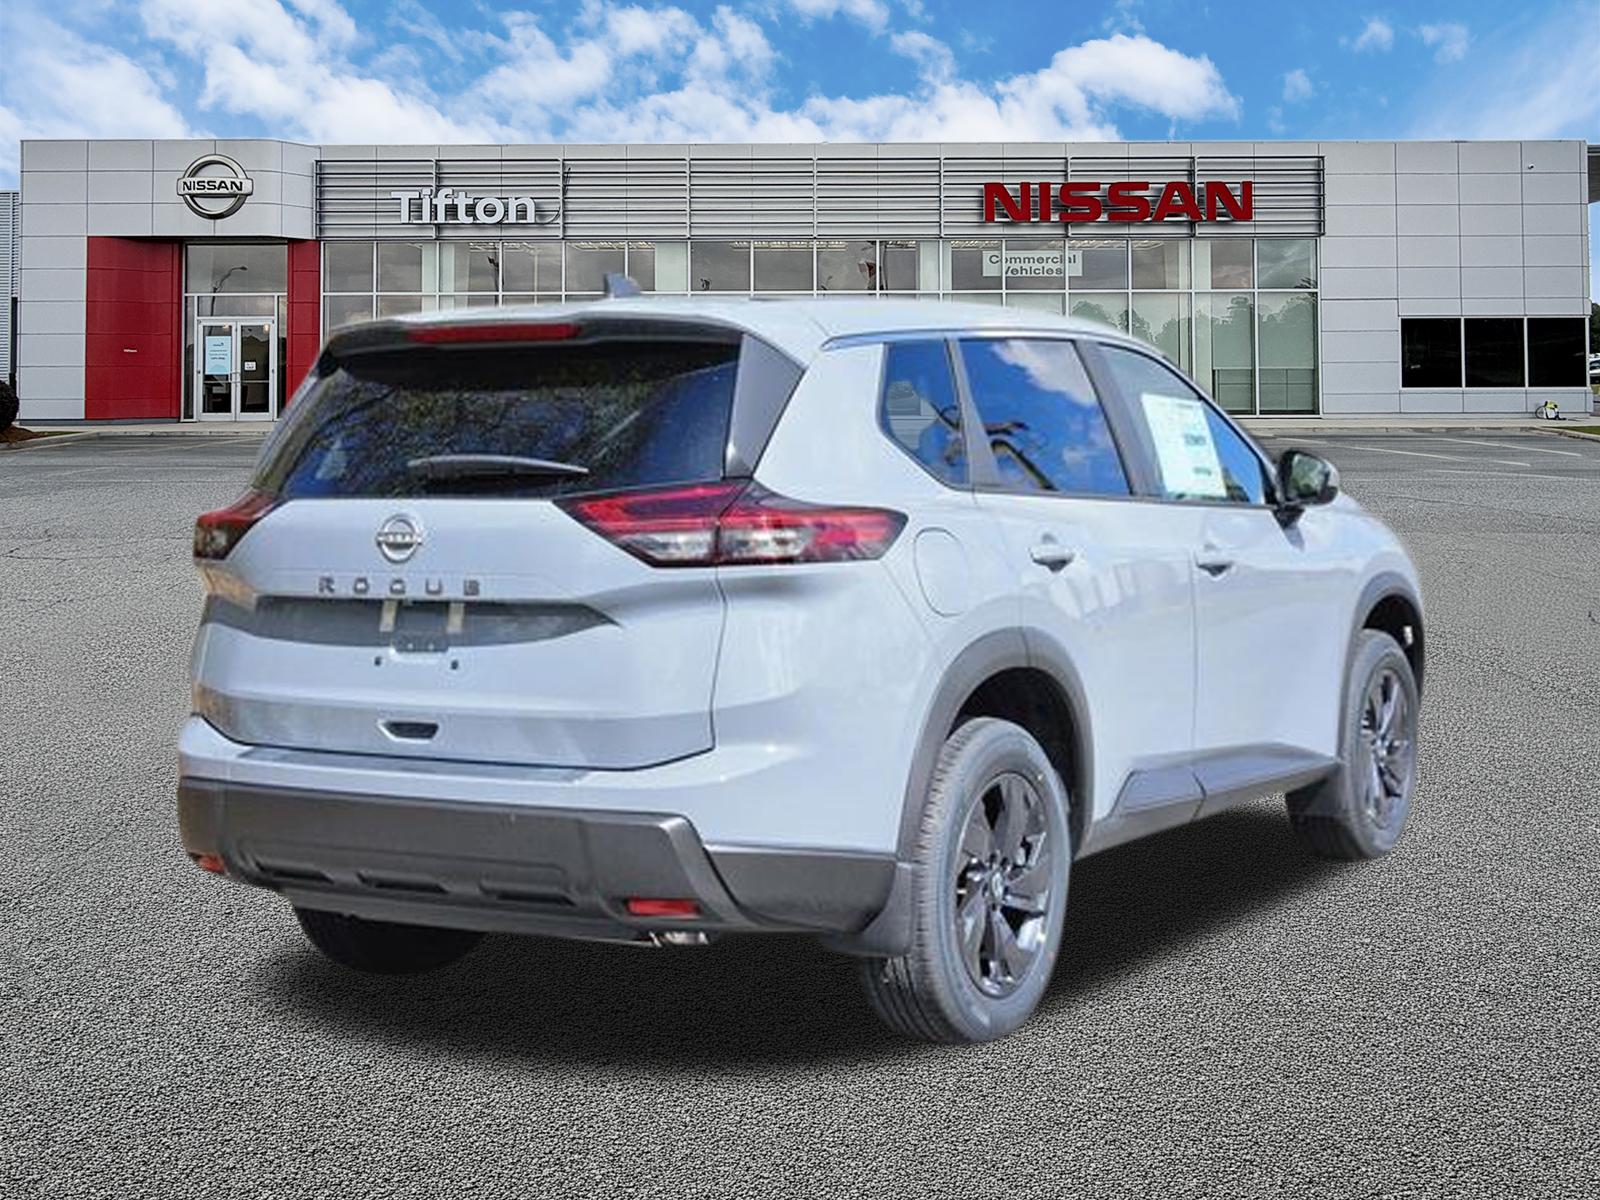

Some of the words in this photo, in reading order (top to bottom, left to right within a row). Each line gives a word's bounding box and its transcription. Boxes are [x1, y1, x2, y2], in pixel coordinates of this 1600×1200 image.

[183, 181, 243, 191] NISSAN
[984, 181, 1253, 222] NISSAN
[391, 188, 536, 224] Tifton
